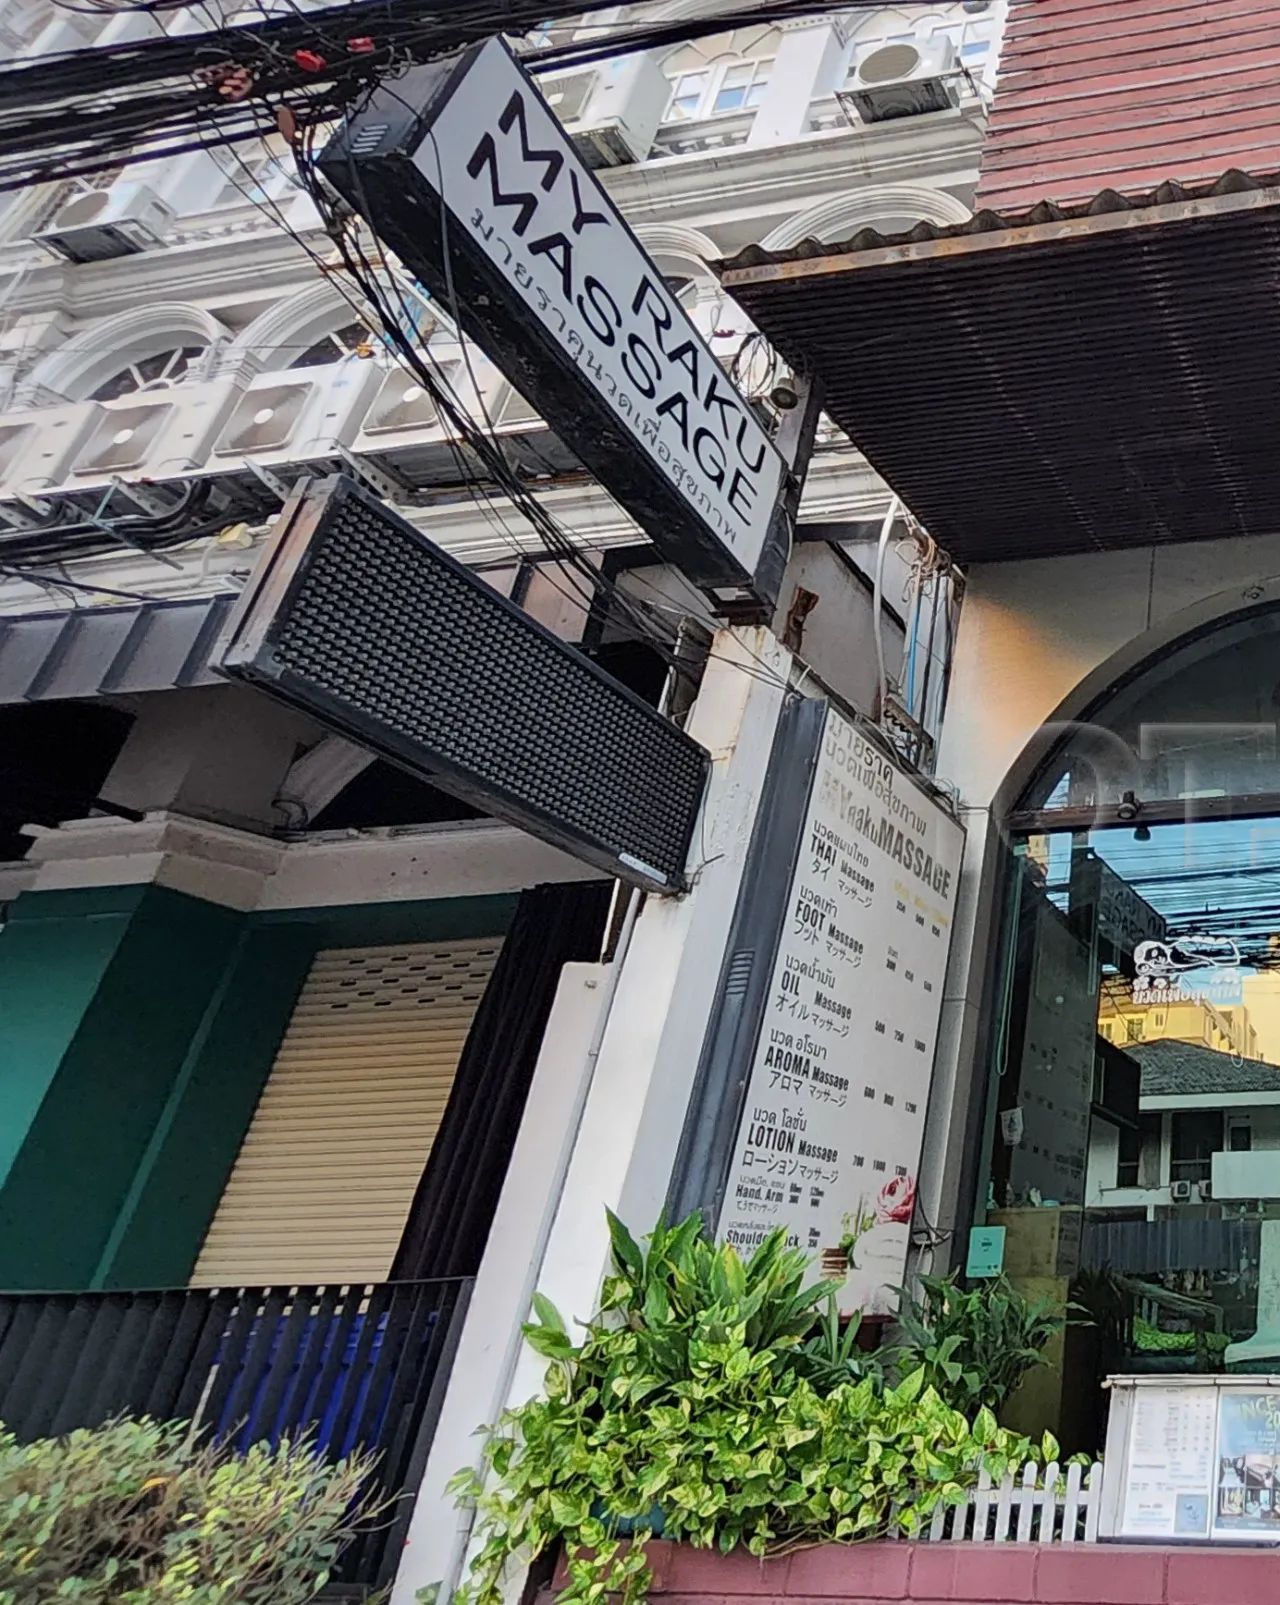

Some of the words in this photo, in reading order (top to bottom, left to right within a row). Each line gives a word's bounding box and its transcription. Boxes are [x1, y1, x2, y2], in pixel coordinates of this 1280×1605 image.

[498, 89, 610, 232] MY
[631, 273, 767, 476] RAKU
[466, 132, 758, 528] MASSAGE
[810, 834, 838, 867] THAI
[840, 859, 875, 893] Massage
[811, 858, 832, 883] タイ
[838, 878, 873, 909] マッサージ
[793, 919, 820, 946] フット
[825, 939, 862, 969] マッサージ
[795, 900, 826, 932] FOOT
[827, 922, 864, 954] Massage
[780, 969, 802, 997] OIL
[814, 990, 852, 1020] Massage
[764, 1045, 811, 1081] AROMA
[811, 1065, 850, 1092] Massage
[768, 1070, 803, 1096] アロマ
[808, 1084, 848, 1108] マッサージ
[747, 1122, 797, 1154] LOTION
[798, 1138, 839, 1163] Massage
[765, 1188, 784, 1203] Arm
[726, 1228, 769, 1245] Shoulde
